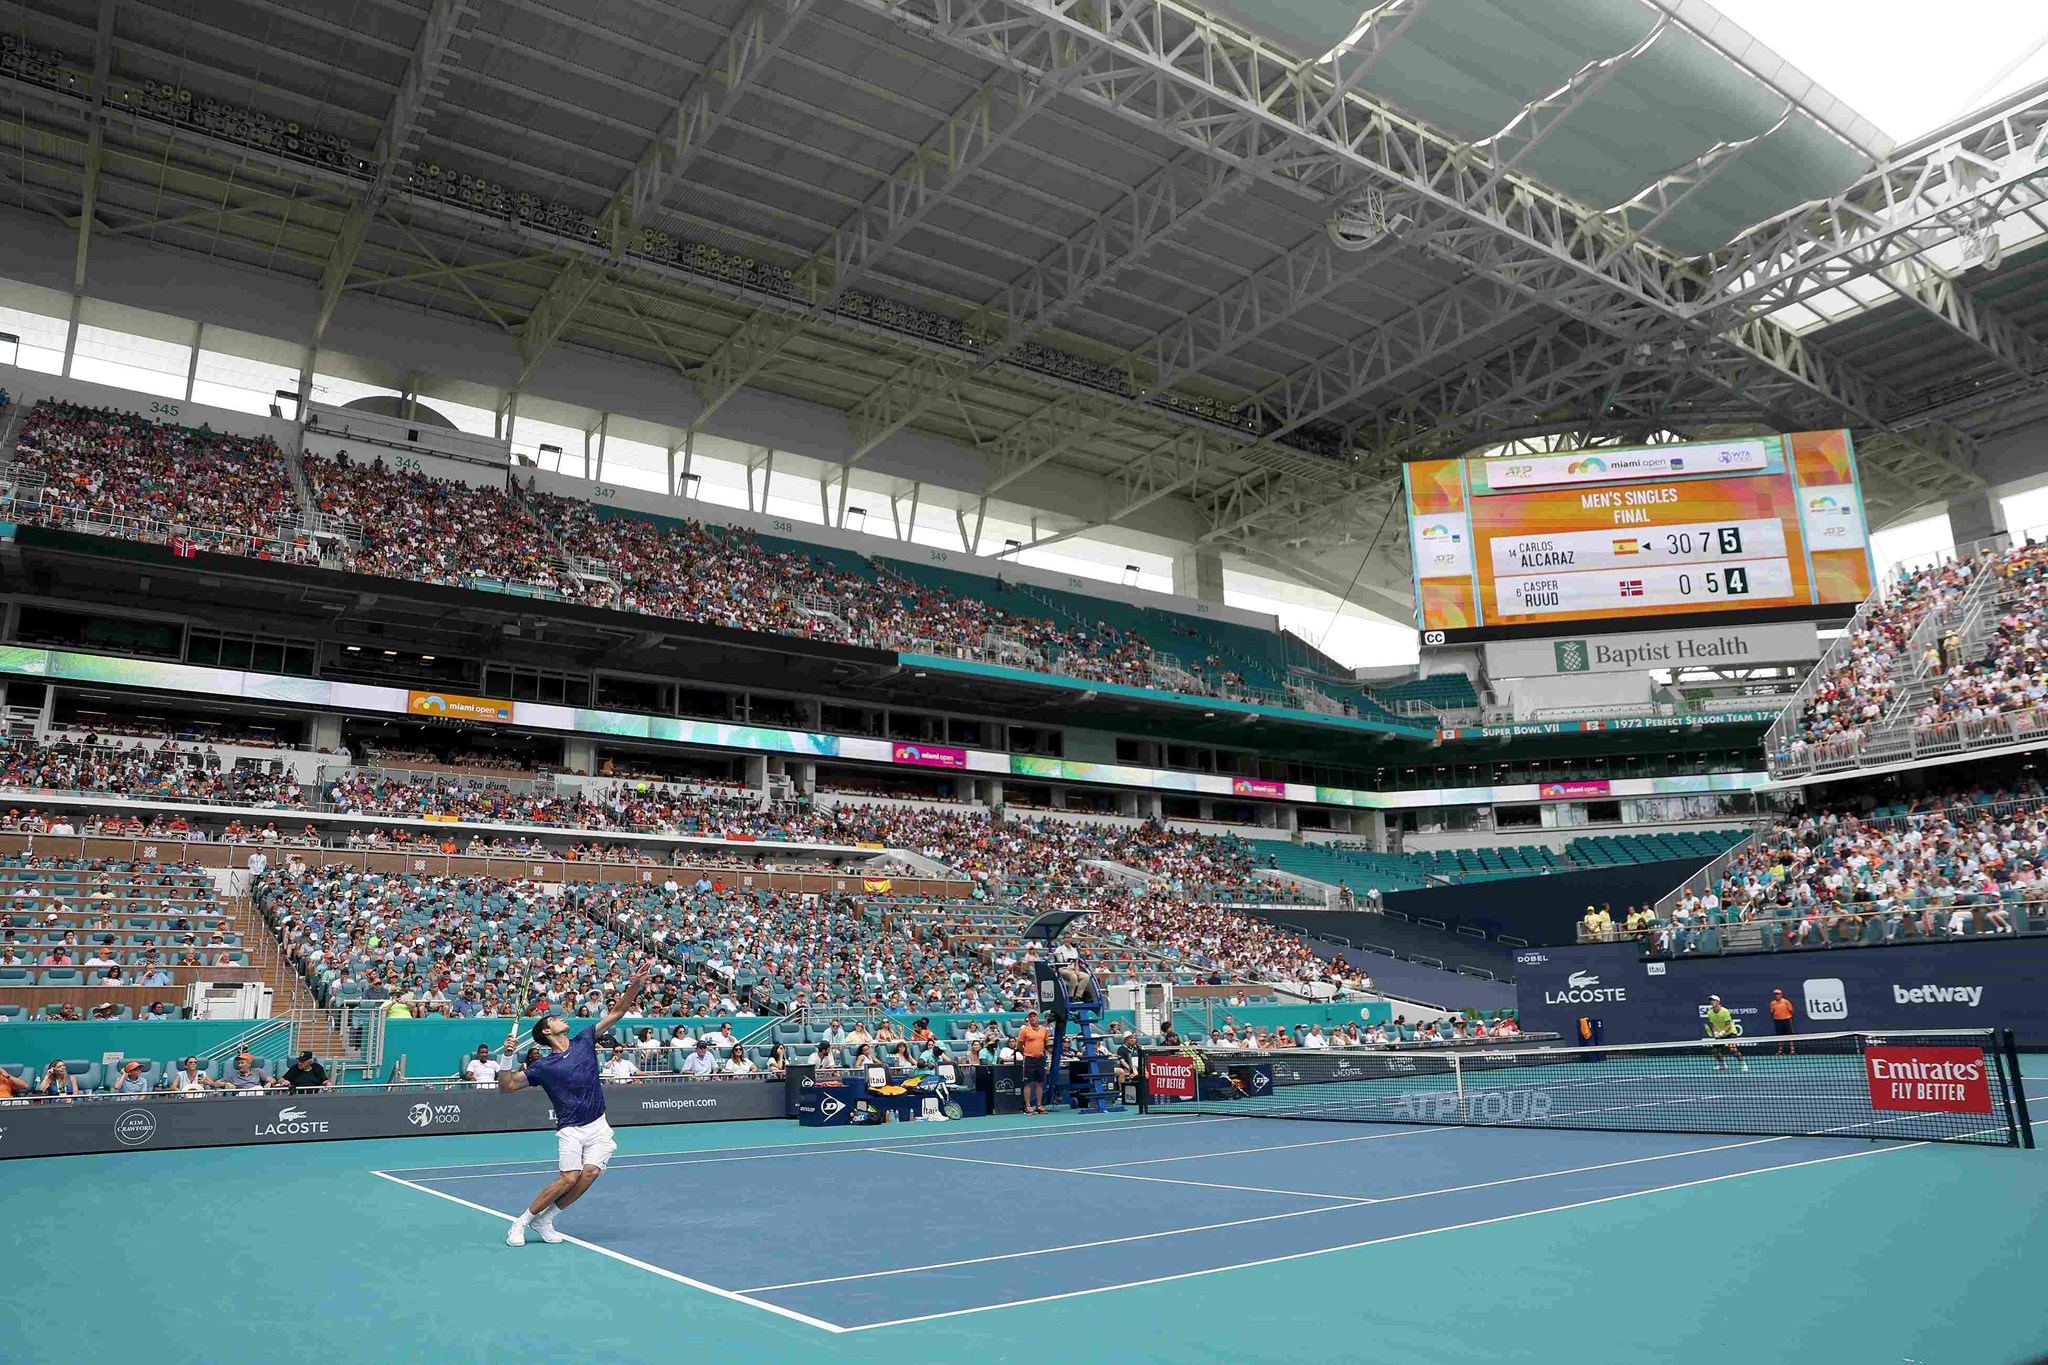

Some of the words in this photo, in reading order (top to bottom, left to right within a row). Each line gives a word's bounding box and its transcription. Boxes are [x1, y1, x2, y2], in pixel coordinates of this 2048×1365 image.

[150, 401, 179, 416] 345
[395, 456, 421, 470] 346
[1611, 459, 1641, 469] miami
[1643, 459, 1666, 468] open
[594, 486, 616, 499] 347
[1581, 491, 1622, 509] MEN'S
[1625, 488, 1678, 506] SINGLES
[1614, 509, 1650, 524] FINAL
[773, 520, 792, 533] 348
[1519, 541, 1553, 553] CARLOS
[1666, 533, 1691, 554] 30
[1699, 532, 1710, 552] 7
[1722, 529, 1737, 551] 5
[930, 551, 947, 562] 349
[1508, 549, 1517, 557] 14
[1521, 551, 1575, 567] ALCARAZ
[1524, 580, 1558, 592] CASPER
[1679, 574, 1691, 595] 0
[1706, 573, 1719, 593] 5
[1730, 570, 1743, 592] 4
[1525, 592, 1559, 607] RUUD
[1426, 632, 1443, 643] CC
[1595, 642, 1671, 667] Baptist
[1676, 636, 1749, 658] Health
[449, 703, 474, 711] miami
[475, 706, 495, 714] open
[1614, 719, 1642, 729] 1972
[1645, 717, 1683, 727] PERFECT
[1686, 715, 1724, 725] SEASON
[1727, 713, 1753, 723] TEAM
[1482, 727, 1510, 737] SUPER
[1514, 725, 1542, 735] BOWL
[1544, 724, 1560, 733] VII
[410, 774, 433, 785] Hard
[1517, 955, 1548, 963] DOBEL
[1545, 988, 1626, 1004] LACOSTE
[1893, 984, 1983, 1007] betway
[1809, 998, 1844, 1014] Itaú
[1891, 1082, 1912, 1099] FLY
[1917, 1083, 1965, 1101] BETTER
[434, 1105, 460, 1114] WTA
[642, 1097, 717, 1110] miamiopen.com
[1463, 1092, 1551, 1121] TOUR
[434, 1115, 460, 1123] 1000
[255, 1121, 329, 1136] LACOSTE
